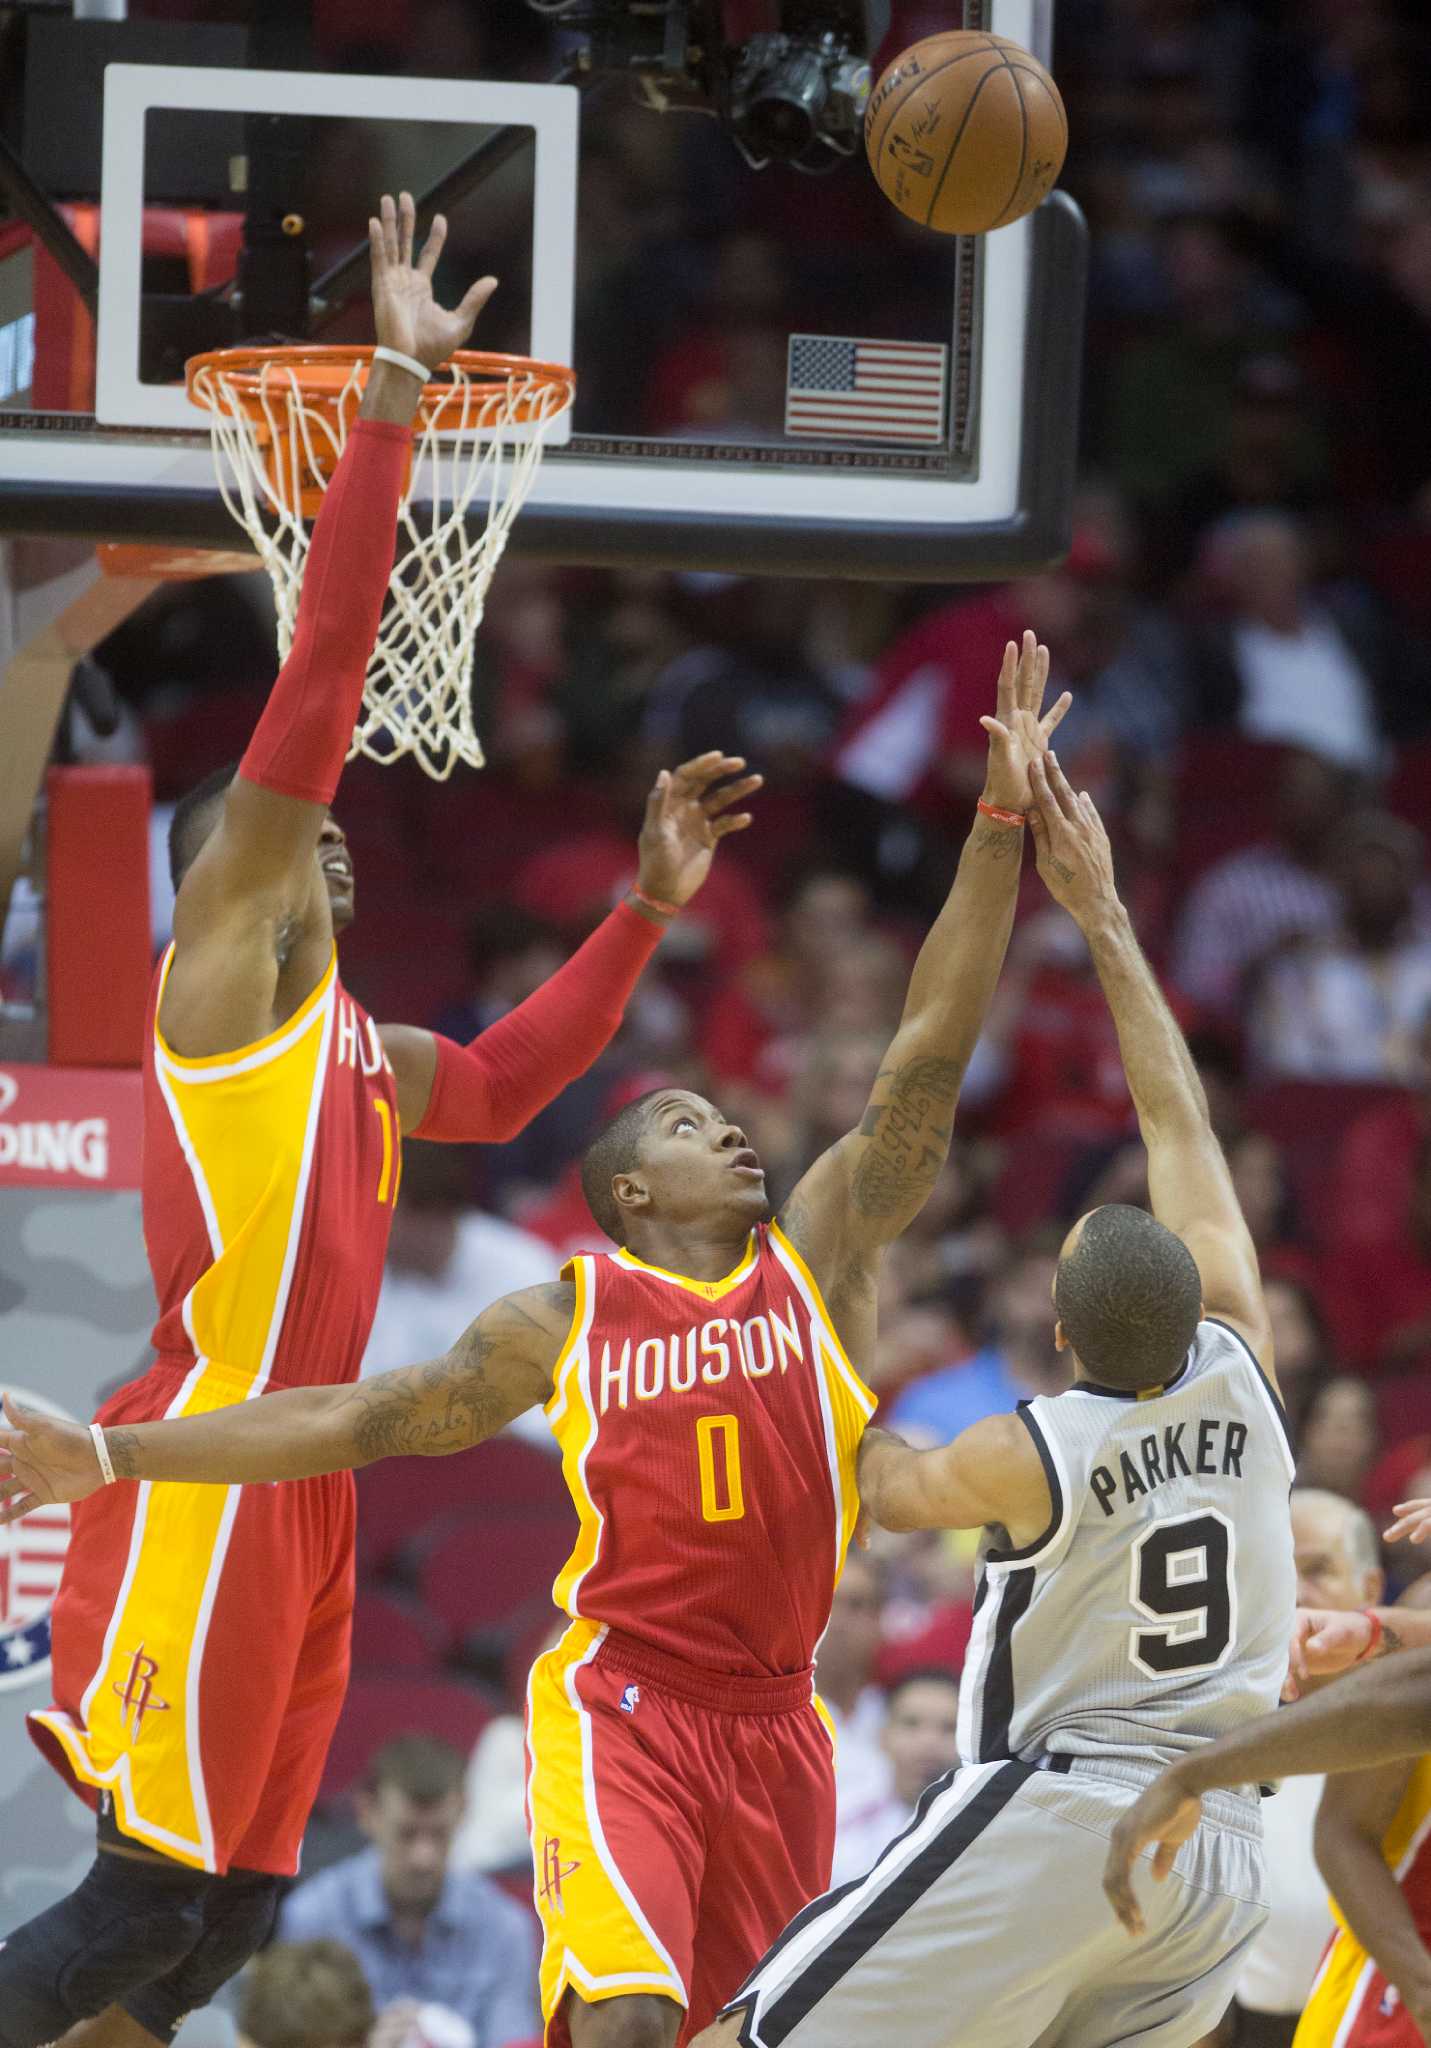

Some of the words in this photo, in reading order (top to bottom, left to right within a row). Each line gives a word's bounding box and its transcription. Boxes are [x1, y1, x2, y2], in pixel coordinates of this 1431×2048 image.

[600, 1295, 804, 1417] HOUSTON
[696, 1414, 745, 1523] 0
[1090, 1419, 1248, 1517] PARKER
[1128, 1506, 1238, 1681] 9
